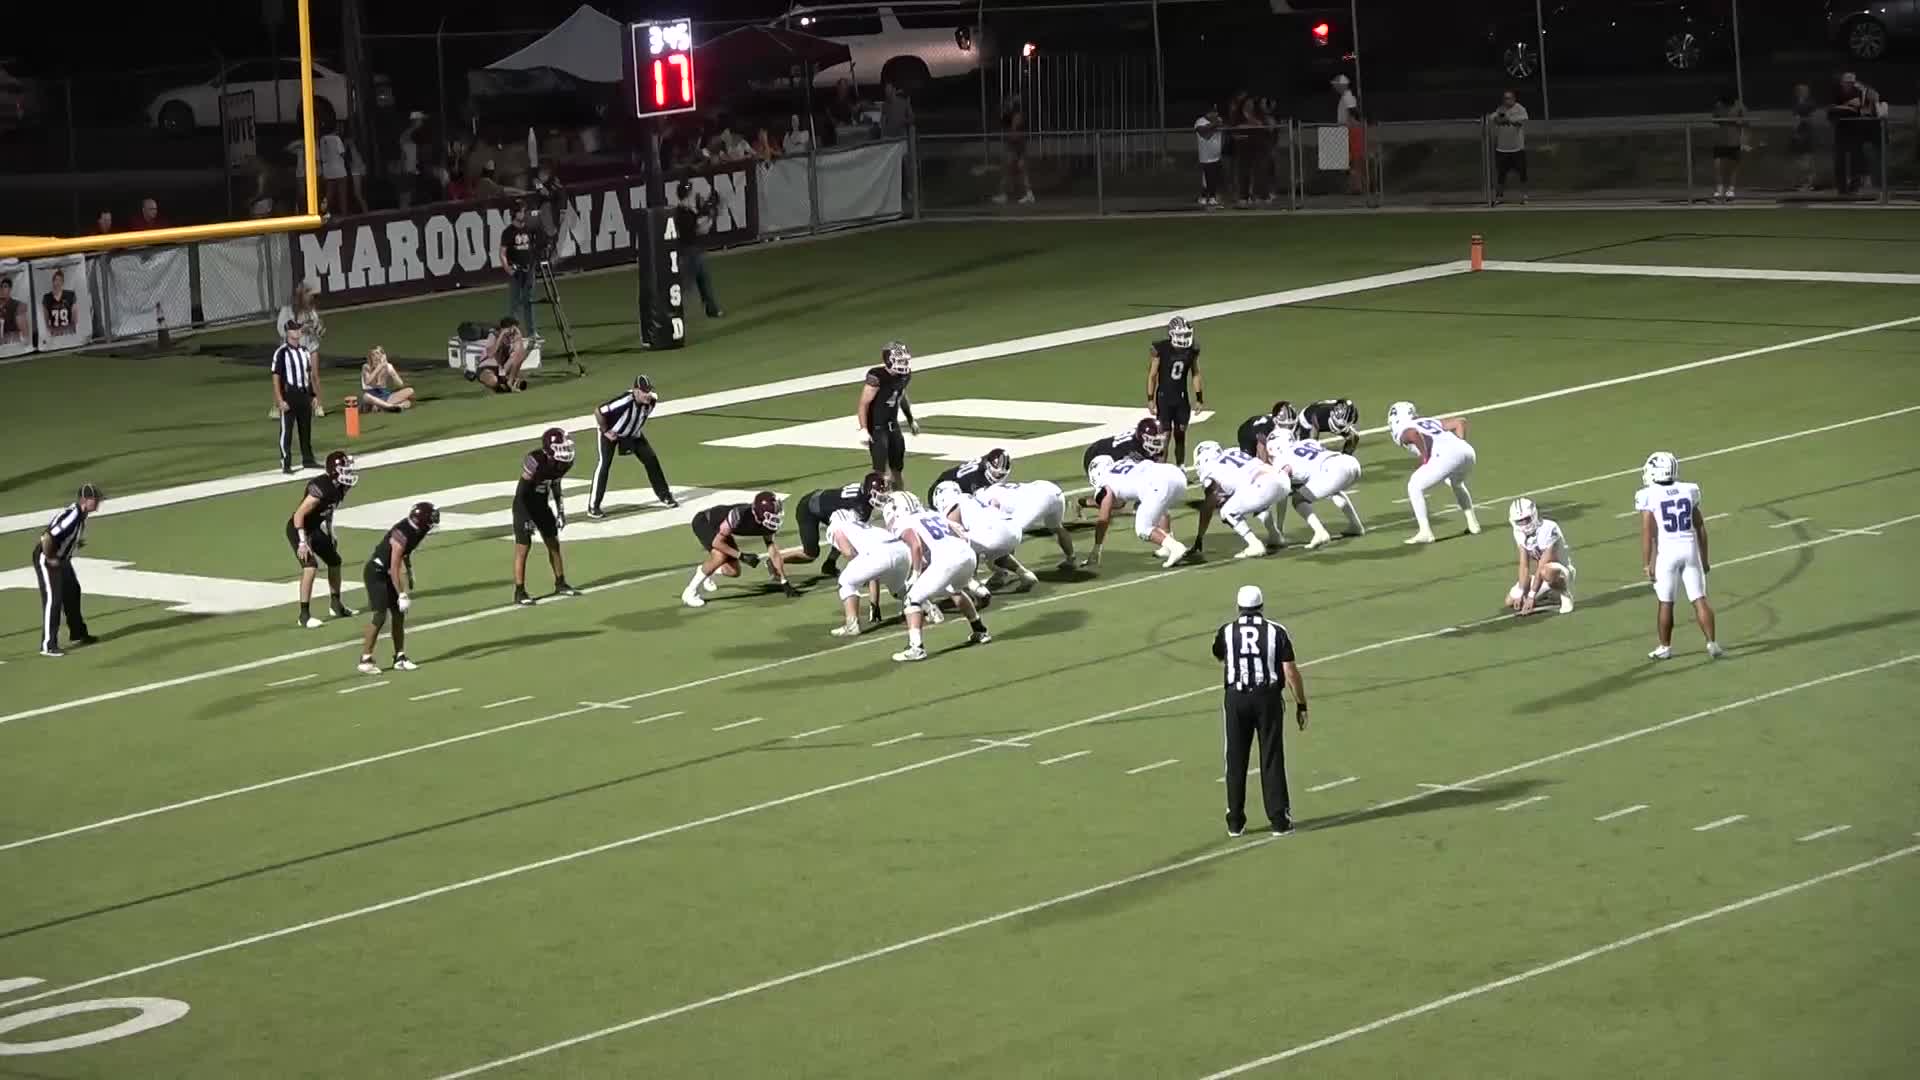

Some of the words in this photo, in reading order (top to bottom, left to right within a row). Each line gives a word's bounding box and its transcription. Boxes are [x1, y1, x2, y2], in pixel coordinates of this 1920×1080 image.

[654, 54, 690, 105] 17
[50, 307, 69, 327] 79
[1170, 360, 1185, 381] 0
[1660, 497, 1692, 533] 52
[1239, 625, 1261, 655] R
